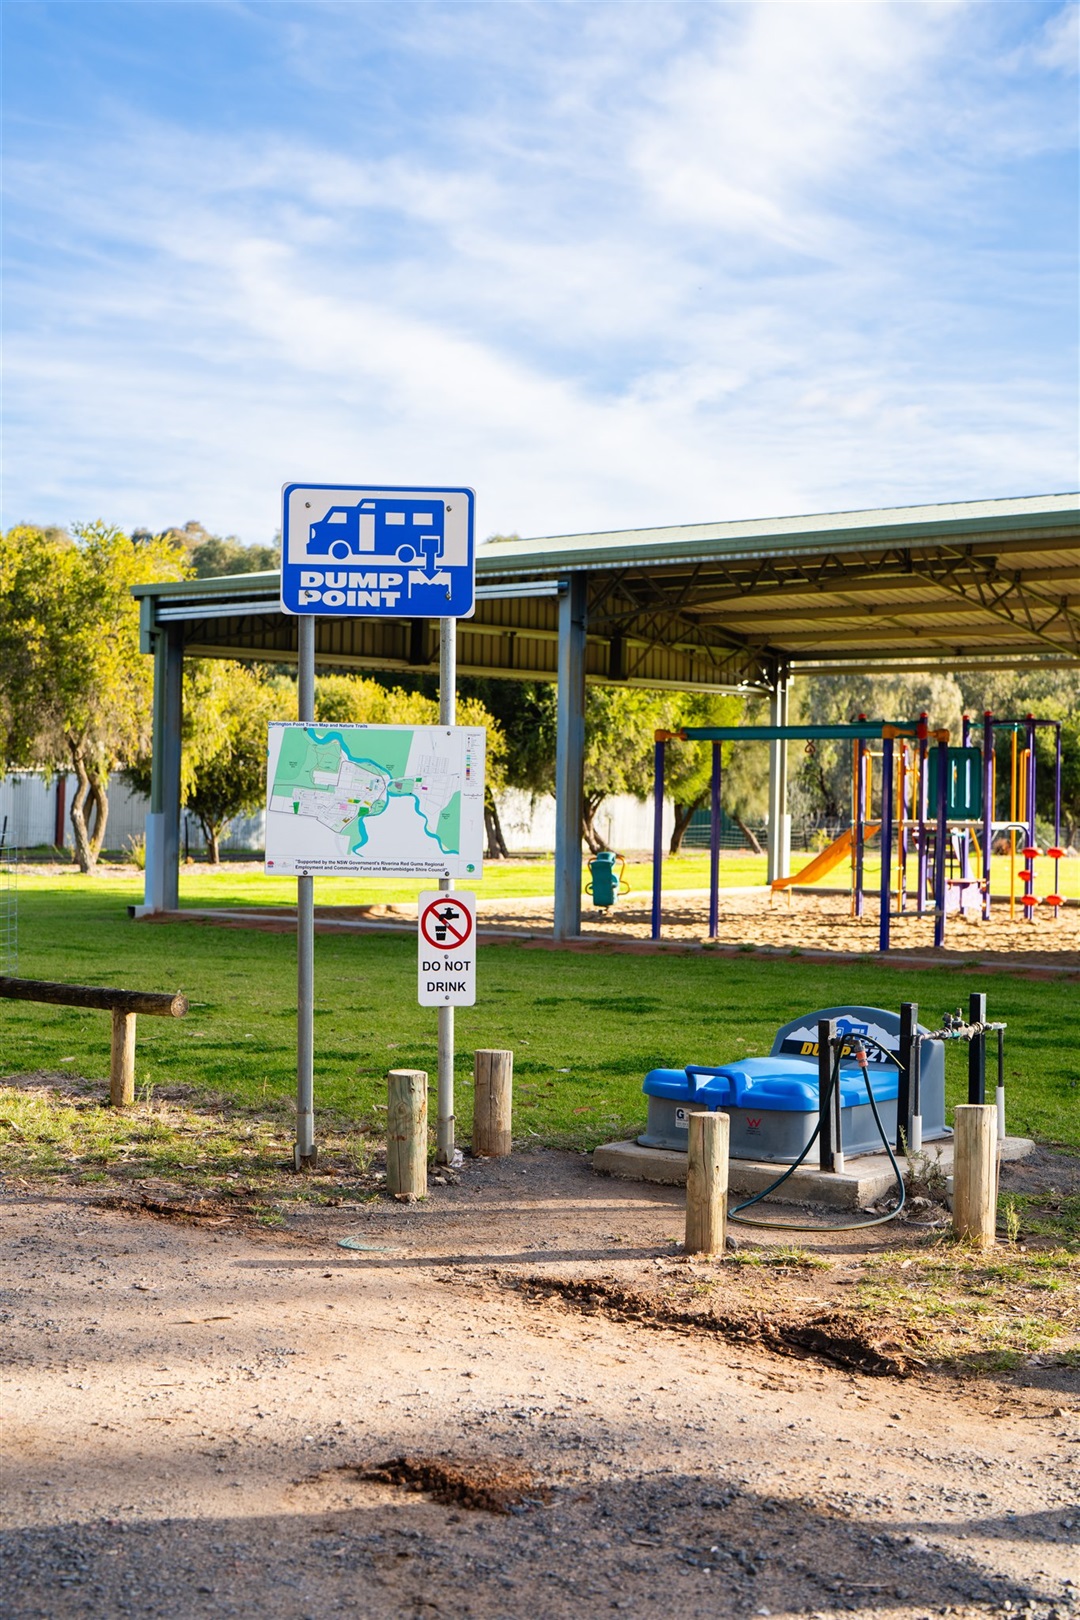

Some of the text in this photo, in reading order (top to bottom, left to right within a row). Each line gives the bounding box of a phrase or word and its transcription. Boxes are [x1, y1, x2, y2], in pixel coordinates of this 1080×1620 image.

[300, 571, 404, 589] DUMP
[298, 589, 401, 607] POINT
[422, 961, 471, 972] DO NOT
[426, 982, 466, 992] DRINK
